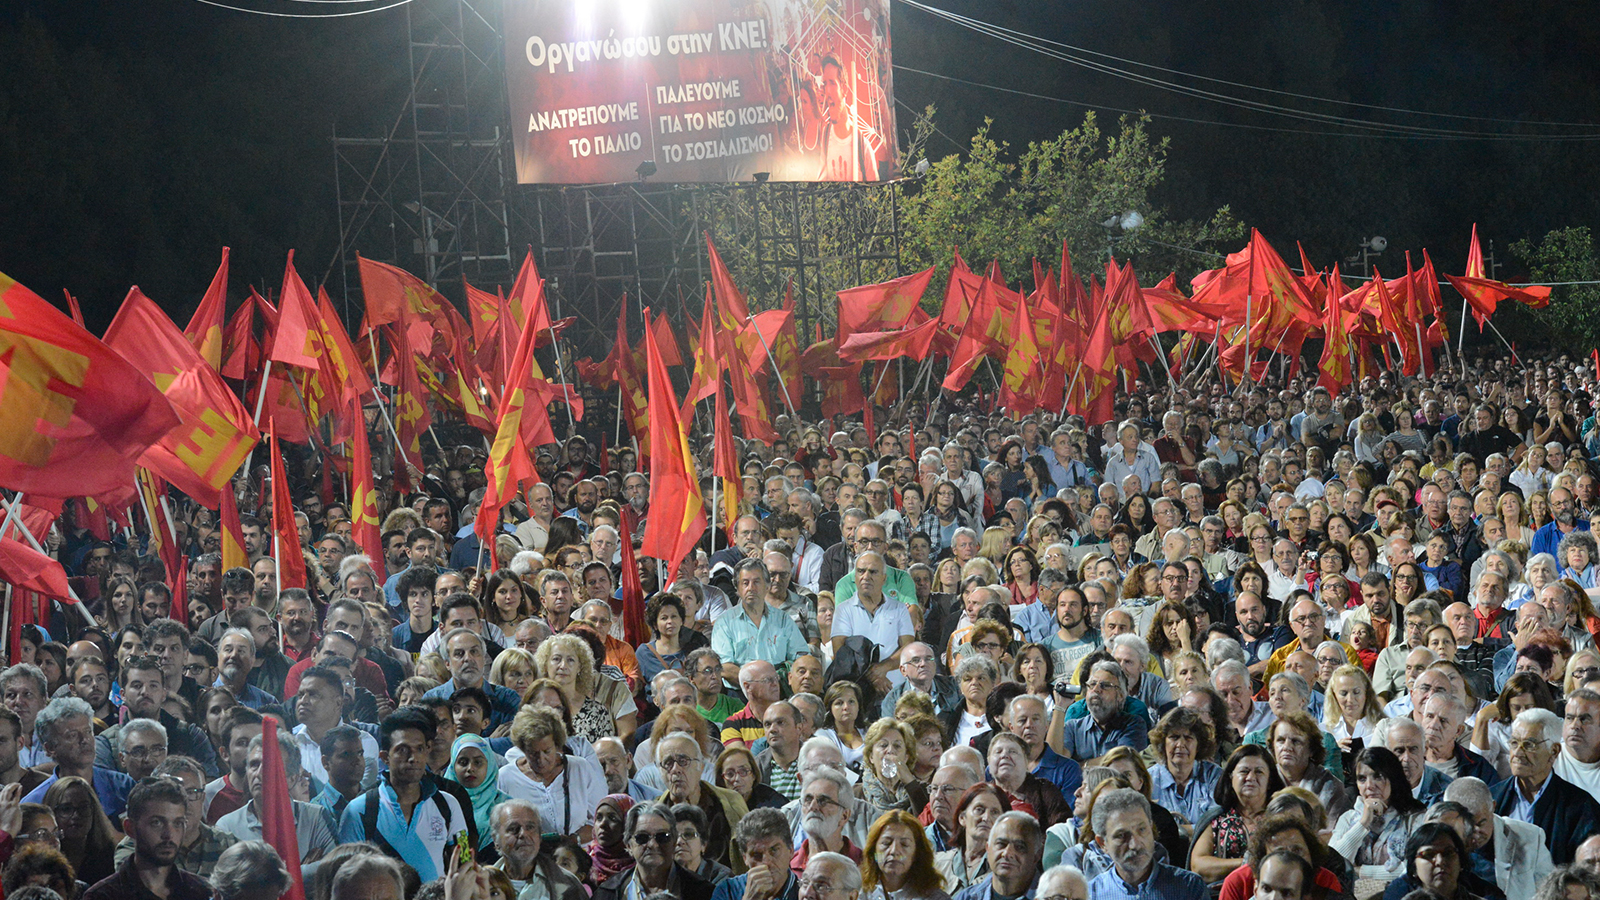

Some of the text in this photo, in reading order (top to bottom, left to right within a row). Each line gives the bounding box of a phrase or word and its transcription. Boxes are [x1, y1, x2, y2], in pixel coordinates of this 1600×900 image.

[526, 19, 768, 74] Οργανώσου στην ΚΝΕ!
[656, 79, 741, 105] ΠΑΛΕΥΟΥΜΕ
[527, 101, 639, 133] ΑΝΑΤΡΕΠΟΥΜΕ
[659, 103, 789, 134] ΓΙΑ ΤΟ ΝΕΟ ΚΟΣΜΟ,
[569, 131, 642, 158] ΤΟ ΠΑΛΙΟ
[662, 133, 773, 163] ΤΟ ΣΟΣΙΑΛΙΣΜΟ!
